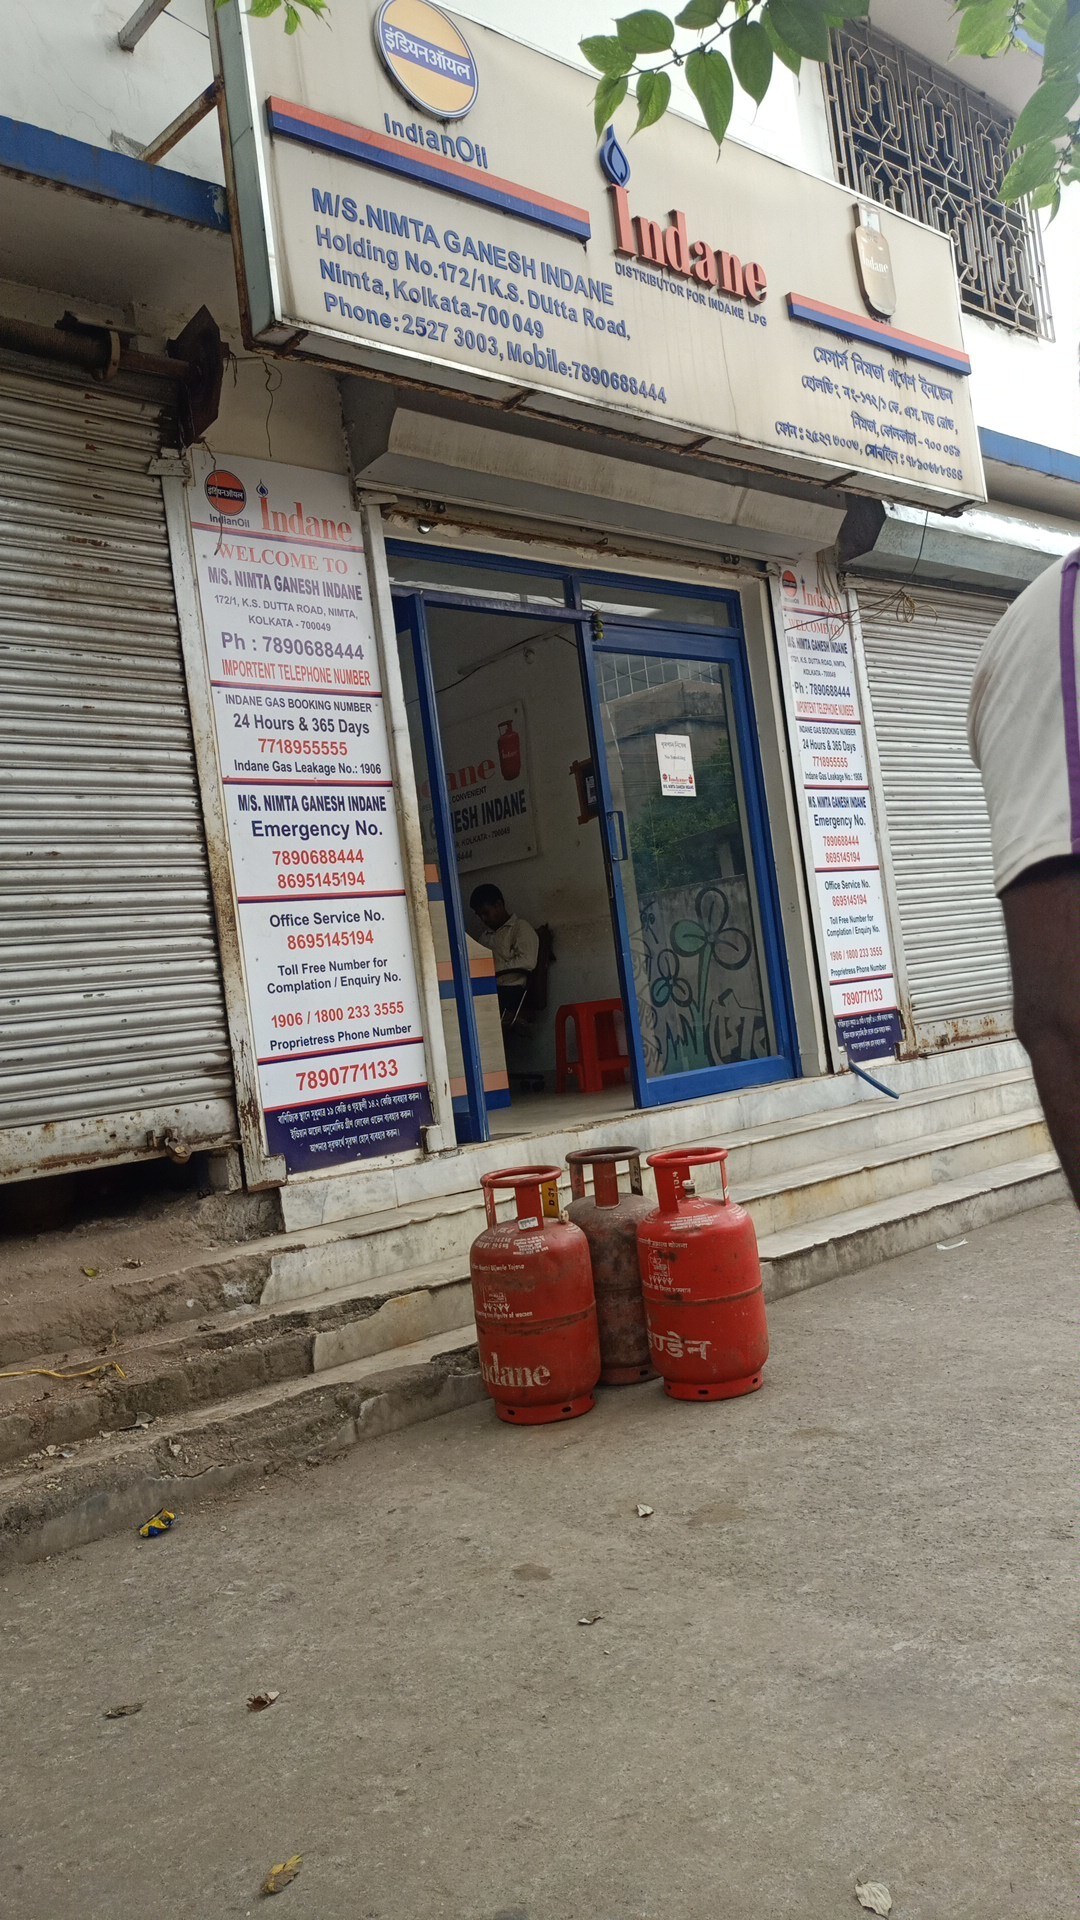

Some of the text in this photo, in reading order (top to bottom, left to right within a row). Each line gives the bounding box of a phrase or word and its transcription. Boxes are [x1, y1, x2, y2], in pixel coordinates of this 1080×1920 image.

[384, 27, 471, 79] इंडियनऑयल
[384, 113, 488, 169] IndianOil
[607, 183, 767, 306] Indane
[444, 230, 536, 280] GANESH
[541, 262, 614, 306] INDANE
[862, 257, 888, 272] Indane
[316, 225, 399, 270] Holding
[583, 308, 631, 340] Road,
[615, 262, 767, 326] DISTRIBUTOR FOR INDANE LPG
[813, 346, 953, 404] মেসার্স নিমতা গণেশ ইনডেন
[210, 514, 250, 528] IndianOil
[260, 497, 352, 542] Indane
[216, 543, 347, 574] WELCOME TO
[208, 567, 363, 600] M/S. NIMTA GANESH INDANE
[215, 595, 358, 620] 172/1, K.S. DUTTA ROAD, NIMTA,
[249, 615, 293, 628] KOLKATA
[301, 621, 331, 631] 700049
[221, 632, 245, 650] Ph
[263, 637, 364, 660] 7890688444
[222, 659, 370, 685] IMPORTENT TELEPHONE NUMBER
[810, 684, 850, 697] 7890688444
[225, 694, 372, 712] INDANE GAS BOOKING NUMBER
[233, 713, 369, 737] 24 Hours & 365 Days
[258, 739, 347, 756] 7718955555
[803, 739, 809, 749] 24
[810, 740, 826, 750] Hours
[832, 741, 842, 750] 365
[843, 741, 856, 755] Days
[234, 760, 381, 775] Indane Gas Leakage No.: 1906
[813, 756, 848, 767] 7718955555
[238, 795, 386, 811] M/S. NIMTA GANESH INDANE
[452, 786, 487, 803] CONVENIENT
[482, 790, 527, 825] INDANE
[252, 821, 382, 840] Emergency No.
[814, 814, 866, 829] Emergency No.
[462, 832, 488, 846] KOLKATA
[823, 836, 859, 847] 7890688444
[272, 850, 364, 865] 7890688444
[826, 852, 860, 863] 8695145194
[278, 872, 365, 888] 8695145194
[825, 880, 870, 890] Office Service No.
[832, 894, 867, 906] 8695145194
[270, 909, 385, 927] Office Service No.
[287, 930, 374, 950] 8695145194
[278, 958, 387, 976] Toll Free Number for
[267, 972, 401, 994] Complation / Enquiry No.
[842, 989, 882, 1006] 7890771133
[272, 1001, 404, 1028] 1906 / 1800 233 3555
[270, 1024, 411, 1050] Proprietress Phone Number
[296, 1059, 398, 1090] 7890771133
